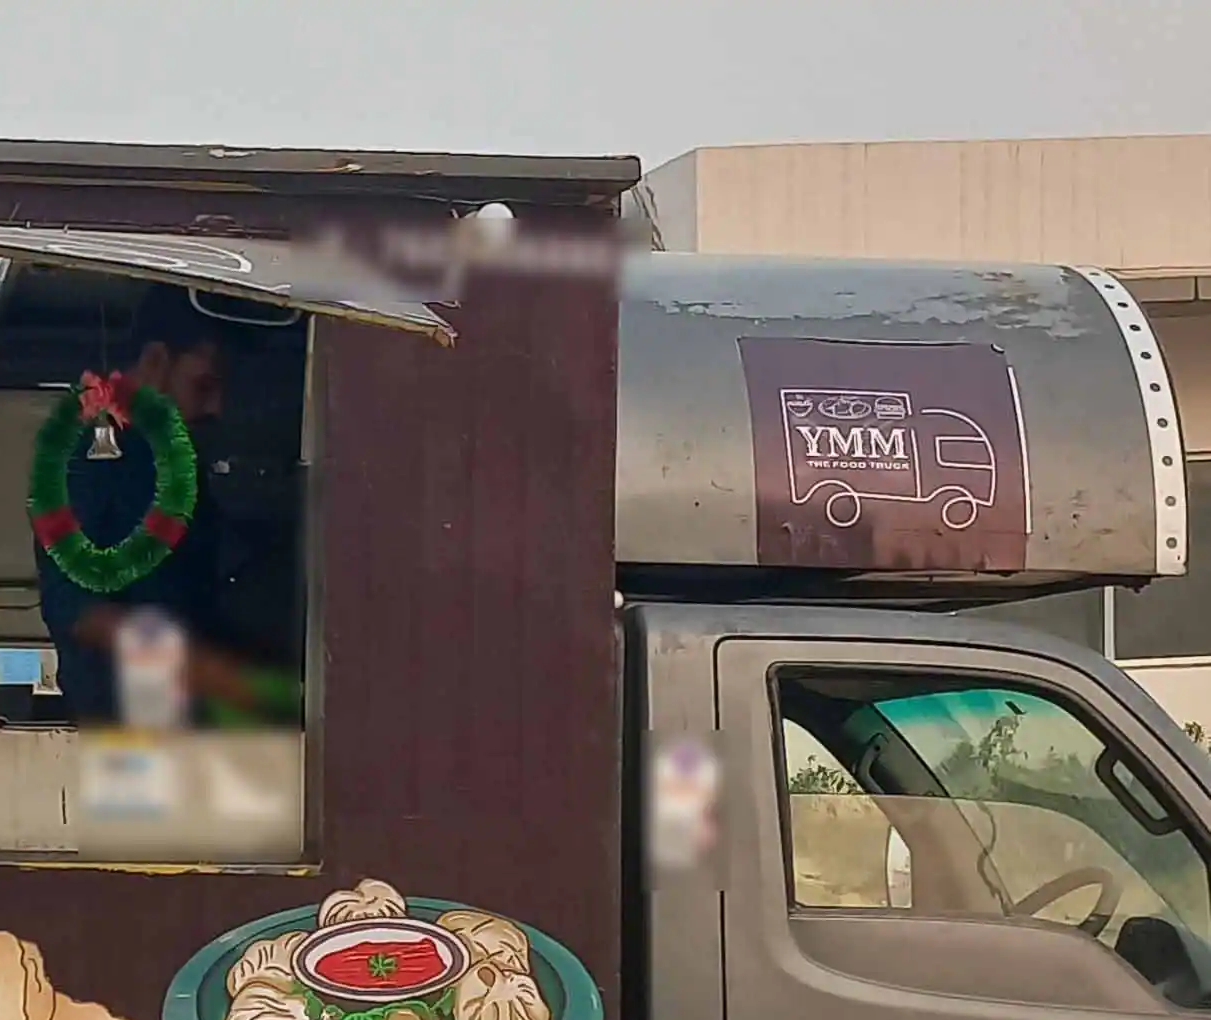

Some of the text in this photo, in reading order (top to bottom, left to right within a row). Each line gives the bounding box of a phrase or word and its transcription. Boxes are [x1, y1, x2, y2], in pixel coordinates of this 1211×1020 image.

[795, 426, 909, 459] YMM
[806, 460, 910, 471] THE FOOD TRUCK
